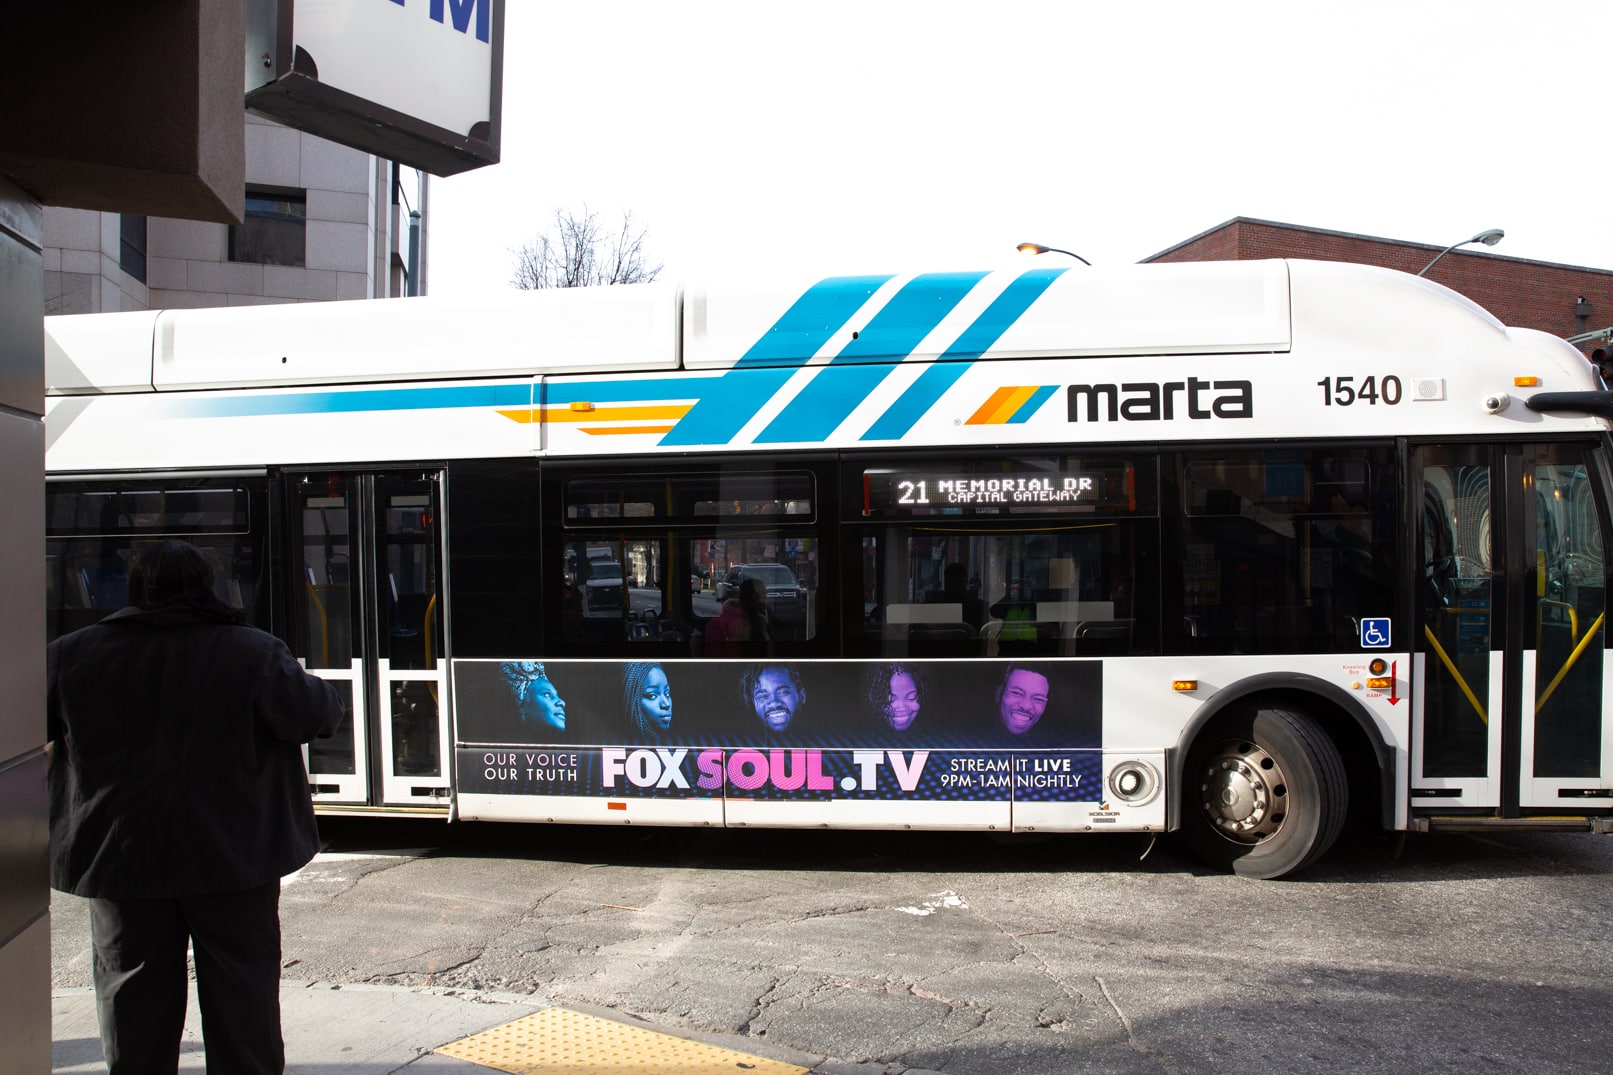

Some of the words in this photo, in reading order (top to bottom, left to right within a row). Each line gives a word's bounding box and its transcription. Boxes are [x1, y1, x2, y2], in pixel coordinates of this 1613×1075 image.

[1317, 375, 1402, 407] 1540
[1067, 376, 1253, 423] marta
[898, 481, 930, 504] 21
[938, 478, 1054, 493] MEMORIAL
[1063, 477, 1093, 491] DR
[948, 490, 1007, 503] CAPITAL
[1013, 489, 1081, 502] GATEWAY
[483, 753, 517, 766] OUR
[525, 753, 577, 767] VOICE
[950, 758, 1010, 772] STREAM
[1016, 759, 1027, 771] IT
[1034, 758, 1071, 771] LIVE
[484, 768, 518, 781] OUR
[526, 768, 577, 782] TRUTH
[602, 747, 690, 789] FOX
[697, 748, 834, 792] SOUL
[940, 774, 1012, 787] 9PM-1AM
[1017, 774, 1082, 788] NIGHTLY
